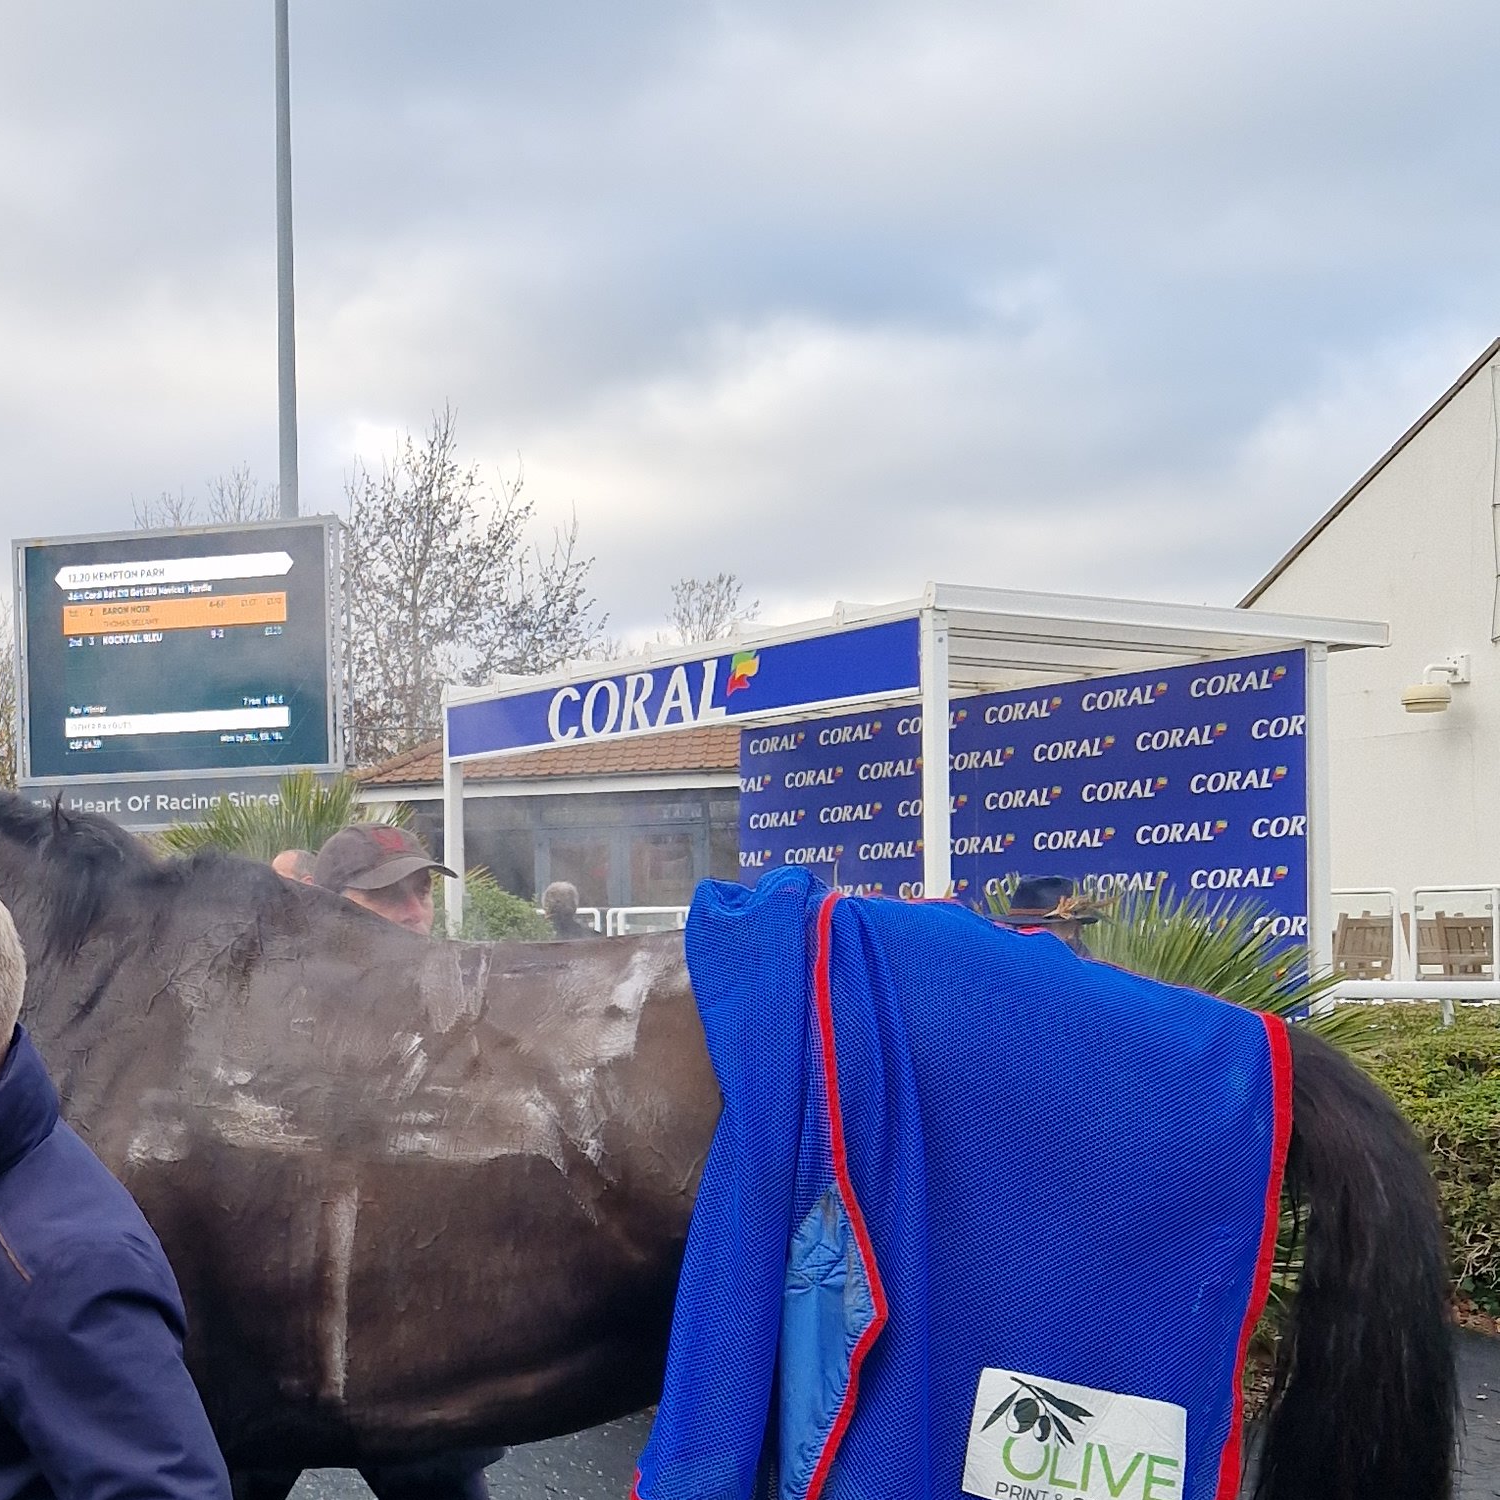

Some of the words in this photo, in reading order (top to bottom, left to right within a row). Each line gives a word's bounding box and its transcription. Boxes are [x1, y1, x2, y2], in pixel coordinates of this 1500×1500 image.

[92, 570, 138, 582] KEMPTON
[140, 567, 165, 579] PARK
[102, 606, 129, 616] BARON
[547, 658, 727, 742] CORAL
[749, 734, 797, 755] CORAL
[819, 723, 873, 746] CORAL
[985, 699, 1050, 724] CORAL
[1081, 685, 1155, 712] CORAL
[1190, 669, 1273, 698] CORAL
[740, 776, 764, 793] RAL
[784, 768, 835, 789] CORAL
[858, 758, 916, 780] CORAL
[1033, 737, 1103, 762] CORAL
[1136, 725, 1214, 752] CORAL
[1251, 714, 1305, 739] COR
[71, 797, 121, 813] Heart
[127, 794, 151, 812] Of
[156, 792, 220, 813] Racing
[749, 810, 798, 829] CORAL
[819, 803, 874, 824] CORAL
[985, 787, 1051, 810] CORAL
[1081, 778, 1155, 803] CORAL
[1190, 768, 1273, 794] CORAL
[740, 851, 764, 867] RAL
[784, 846, 836, 865] CORAL
[858, 840, 916, 861] CORAL
[1033, 828, 1103, 851] CORAL
[1136, 821, 1214, 845] CORAL
[1251, 815, 1306, 838] COR
[1190, 866, 1275, 890] CORAL
[1253, 916, 1306, 936] COR
